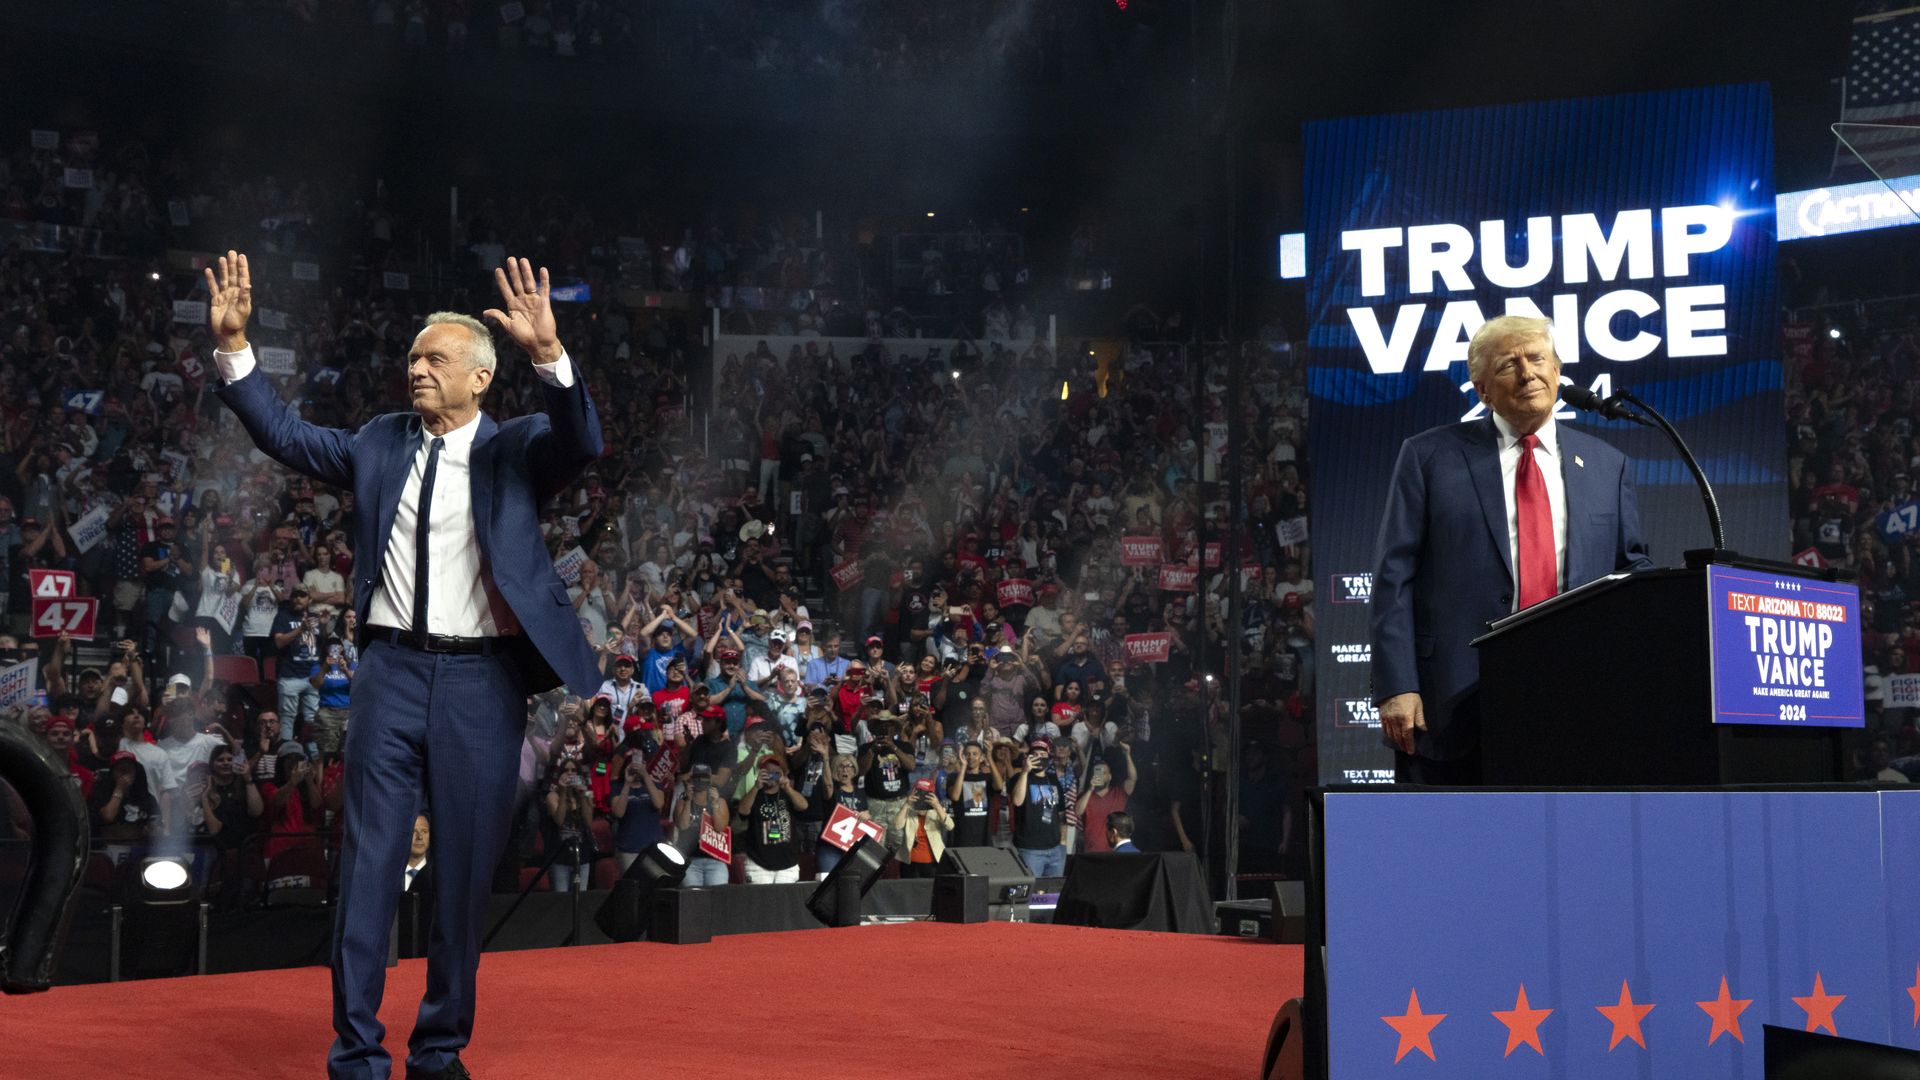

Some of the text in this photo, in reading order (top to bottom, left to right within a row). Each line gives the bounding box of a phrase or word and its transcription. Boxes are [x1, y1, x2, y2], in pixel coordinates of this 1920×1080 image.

[1342, 204, 1733, 297] TRUMP
[67, 392, 101, 411] 47
[1459, 373, 1612, 423] 224
[1885, 504, 1918, 534] 47
[1123, 543, 1160, 551] TRUMP
[36, 574, 72, 597] 47
[37, 602, 89, 631] 47
[1731, 593, 1843, 622] TEXT ARIZONA TO 88022
[1126, 639, 1168, 650] TRUMP
[1744, 615, 1833, 658] TRUMP
[1130, 646, 1163, 656] VANCE
[1331, 644, 1362, 653] MAKE
[1336, 653, 1371, 663] GREAT
[1756, 654, 1825, 687] VANCE
[1753, 687, 1830, 699] MAKE AMERICA GREAT AGAIN!
[1779, 704, 1807, 721] 2024
[1343, 769, 1395, 778] TEXT TRU
[701, 833, 730, 854] TRUMP
